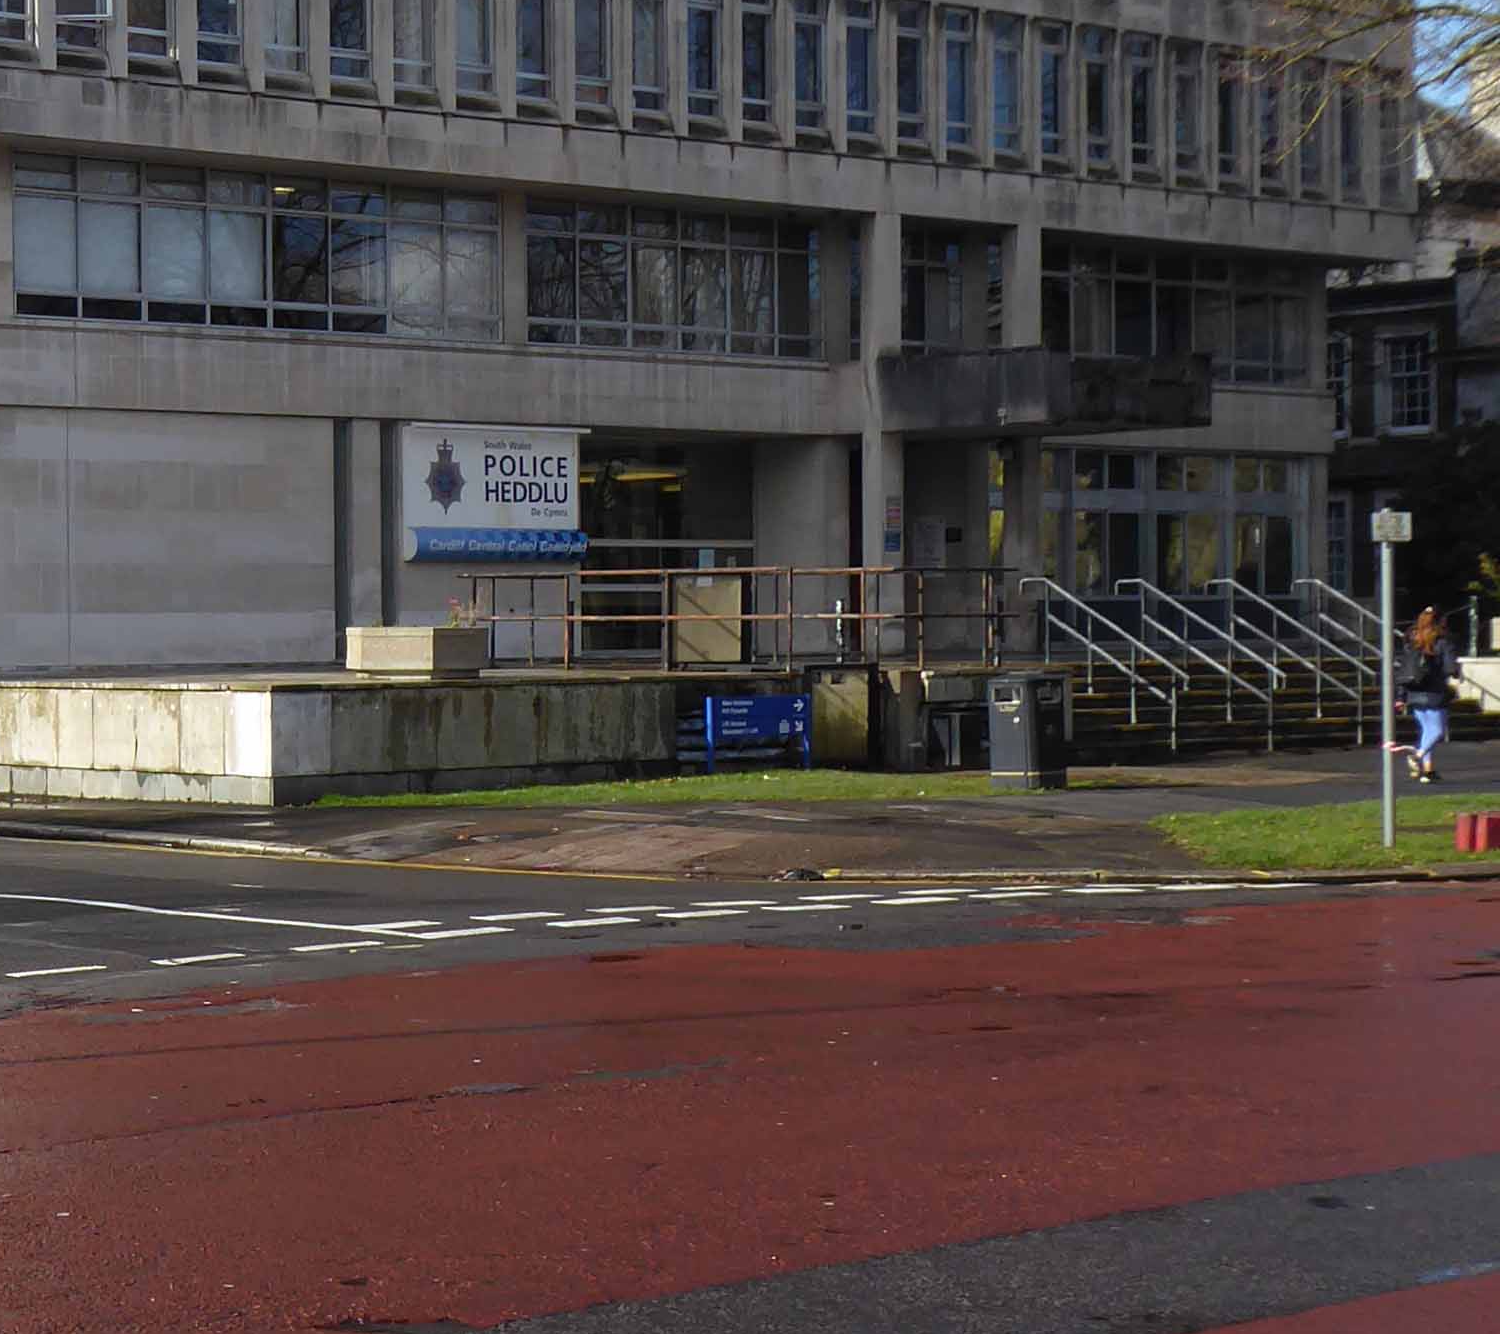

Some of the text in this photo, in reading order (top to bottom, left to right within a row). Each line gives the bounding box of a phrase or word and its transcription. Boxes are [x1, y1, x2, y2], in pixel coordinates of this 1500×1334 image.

[484, 440, 532, 451] South Wales
[484, 454, 568, 478] POLICE
[485, 480, 568, 503] HEDDLU
